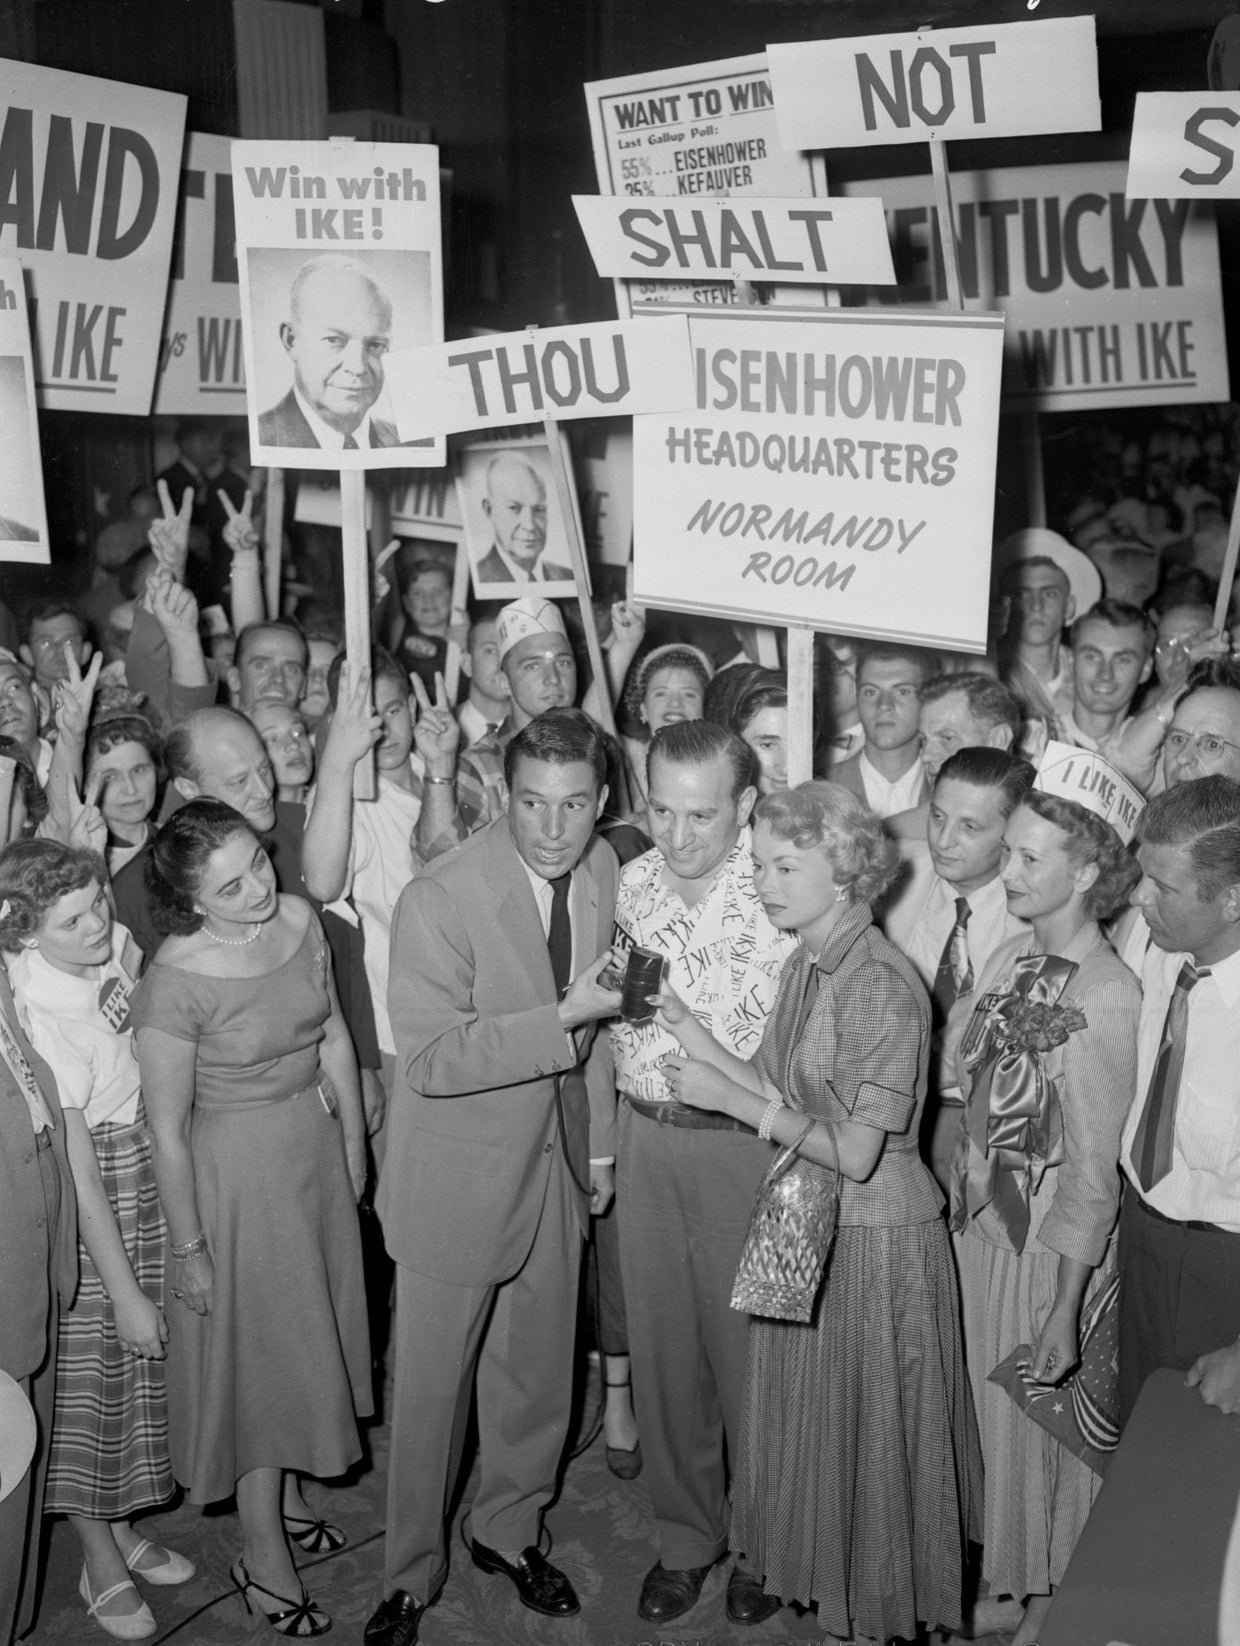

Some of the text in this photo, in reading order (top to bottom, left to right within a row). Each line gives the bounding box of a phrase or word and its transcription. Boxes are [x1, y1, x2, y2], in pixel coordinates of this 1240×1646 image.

[614, 95, 681, 129] WANT
[688, 89, 722, 118] TO
[855, 41, 997, 132] NOT
[618, 125, 718, 150] Last Gallup Poll:
[674, 138, 767, 172] EISENHOWER
[1179, 107, 1240, 186] S
[245, 166, 427, 202] Win with
[677, 165, 753, 195] KEFAUVER
[295, 208, 384, 240] IKE!
[618, 208, 834, 272] SHALT
[842, 192, 1190, 307] ENTUCKY
[52, 301, 127, 382] IKE
[1019, 320, 1197, 387] WITH IKE
[448, 333, 630, 417] THOU
[696, 348, 967, 427] ISENHOWER
[665, 426, 959, 486] HEADQUARTERS
[686, 498, 927, 554] NORMANDY
[741, 551, 857, 591] ROOM
[1061, 760, 1137, 829] I LIKE IKE
[107, 980, 127, 1011] LIKE
